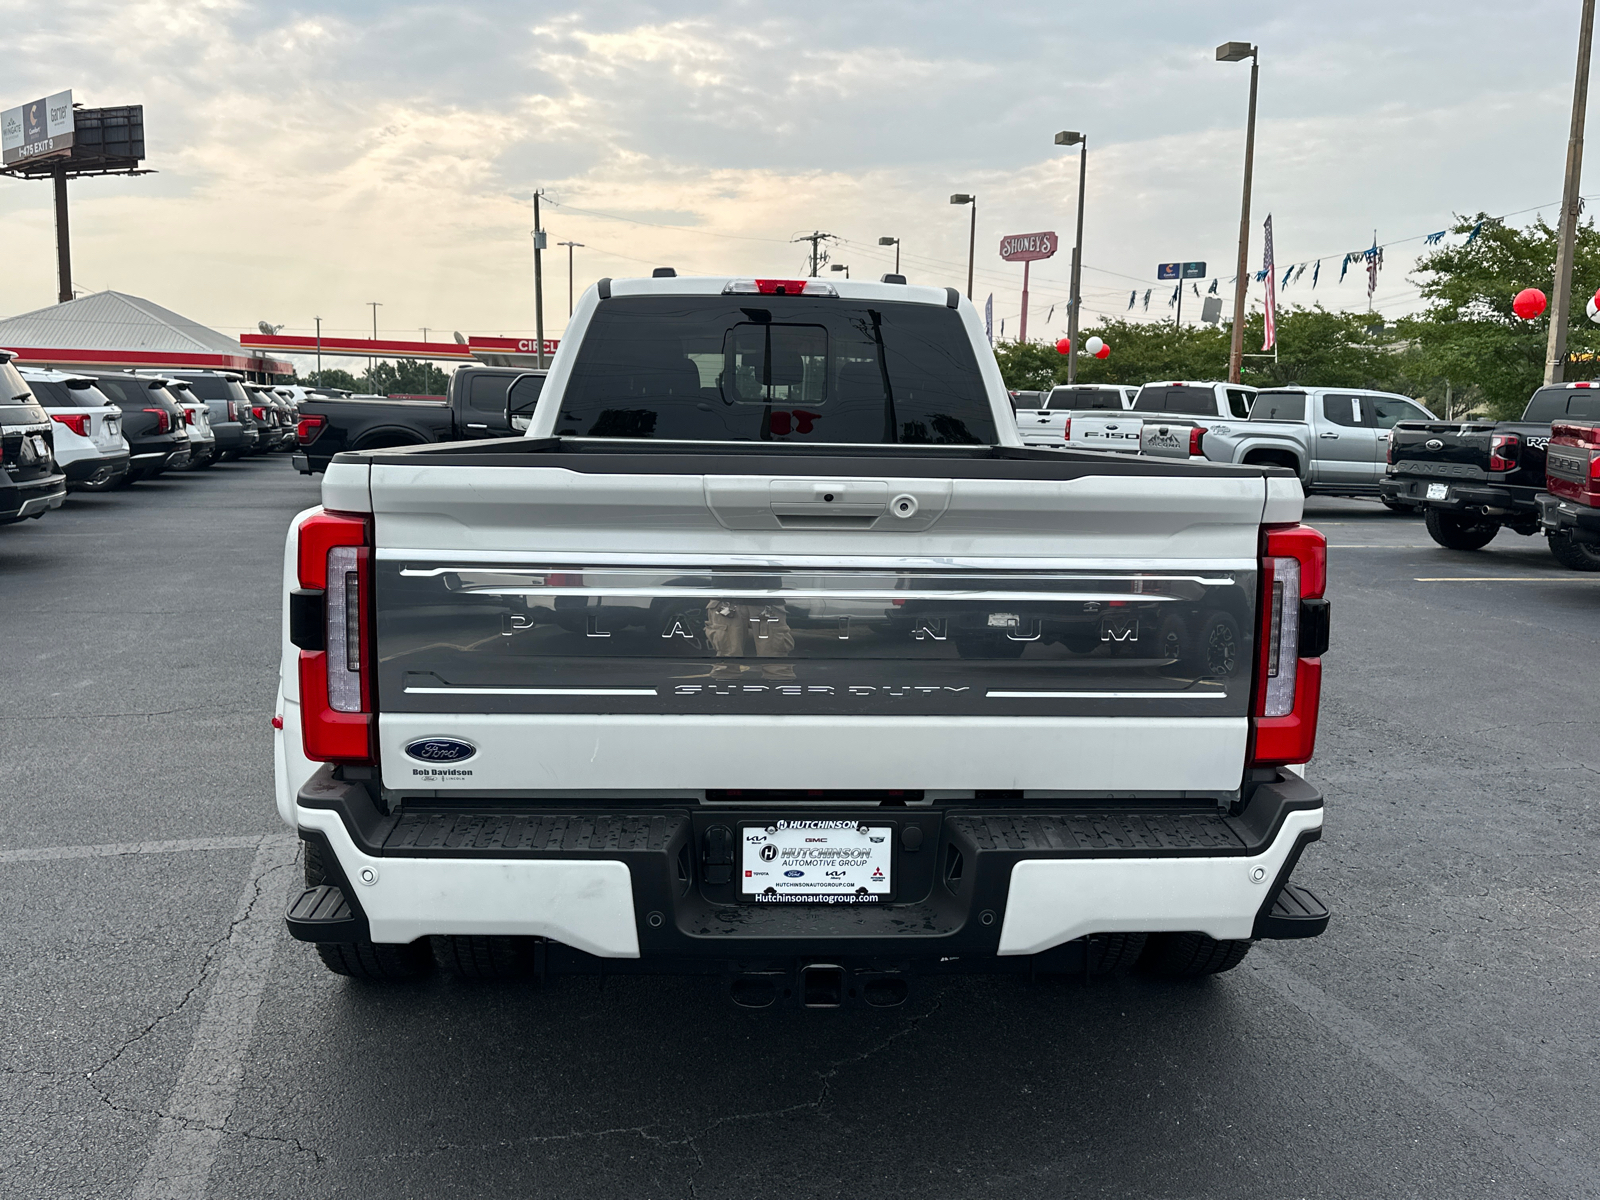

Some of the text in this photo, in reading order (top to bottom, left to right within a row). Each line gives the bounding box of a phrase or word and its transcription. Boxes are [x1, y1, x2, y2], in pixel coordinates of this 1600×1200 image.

[19, 139, 53, 157] I-475 EXIT 9
[1002, 235, 1050, 256] SHONEY'S
[518, 340, 560, 351] CIRCL
[1399, 462, 1479, 477] RANGER
[502, 612, 1139, 642] PLATINUM
[675, 684, 970, 697] SUPER DUTY
[421, 742, 460, 758] Ford
[789, 820, 859, 829] HUTCHINSON
[780, 848, 872, 859] HUTCHINSON
[755, 893, 879, 904] Hutchinsonautogroup.com
